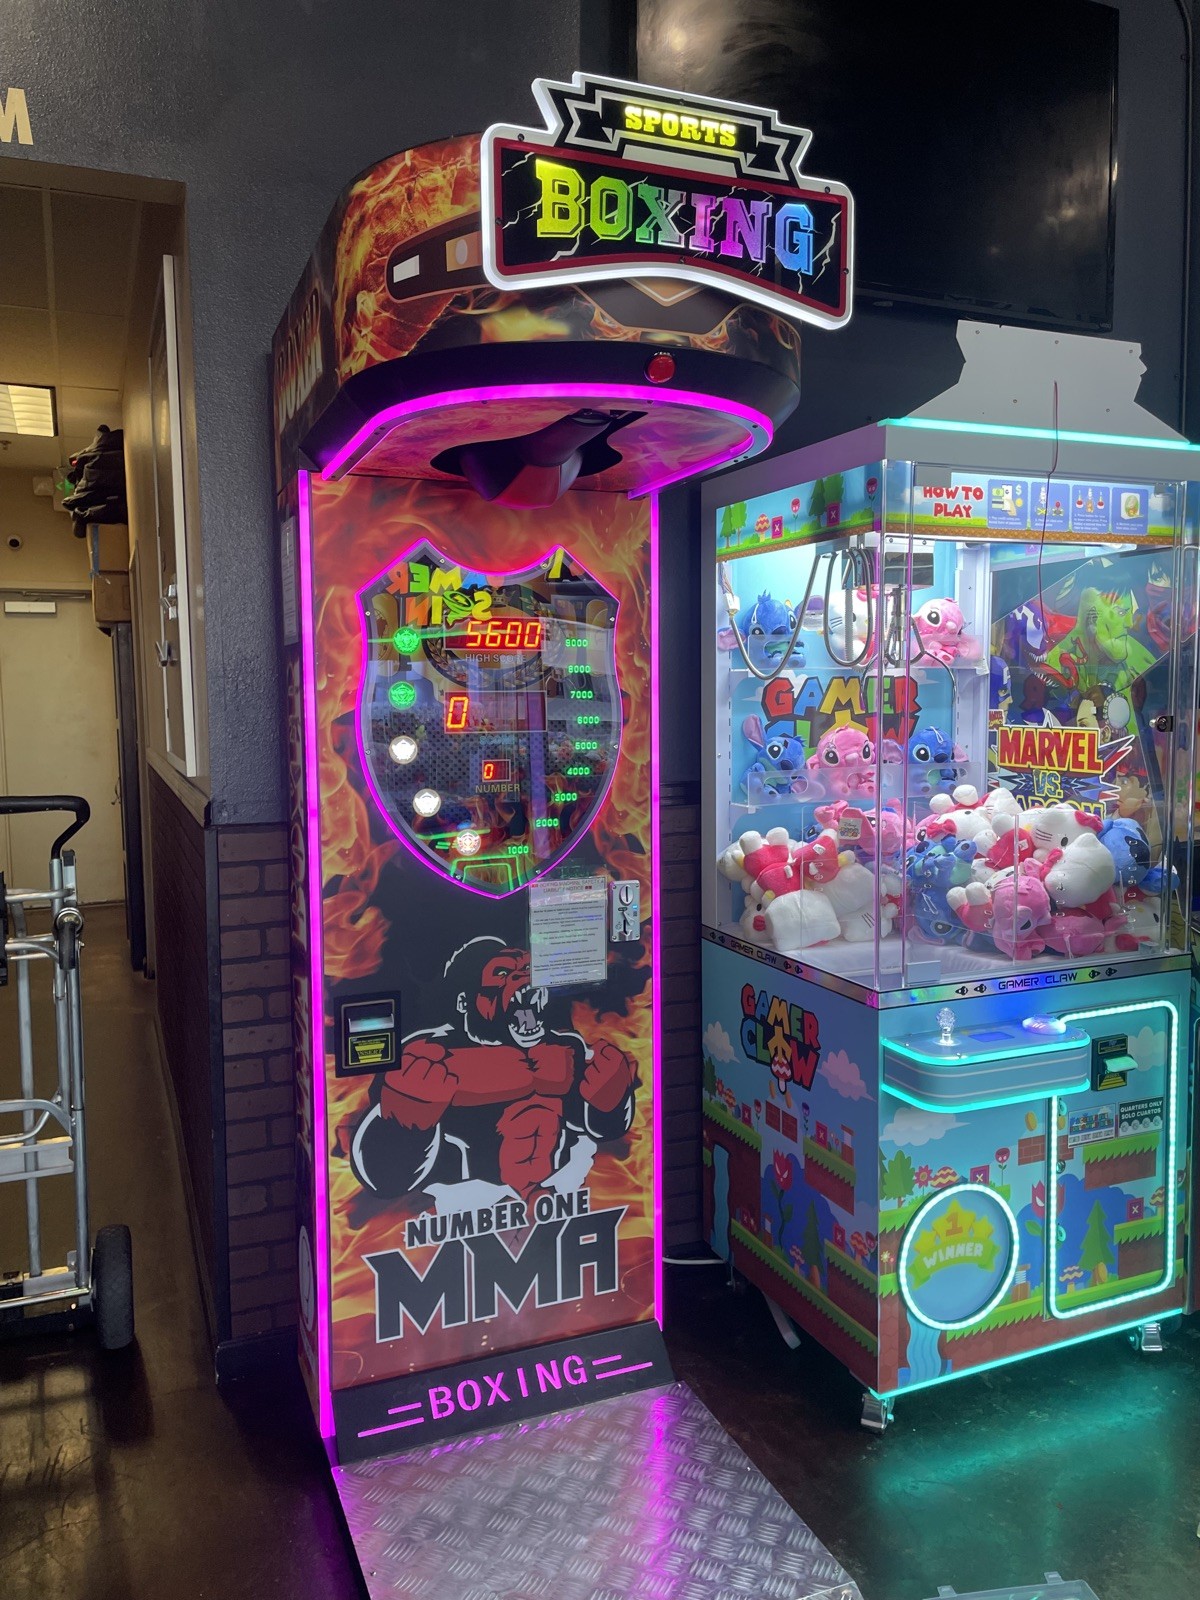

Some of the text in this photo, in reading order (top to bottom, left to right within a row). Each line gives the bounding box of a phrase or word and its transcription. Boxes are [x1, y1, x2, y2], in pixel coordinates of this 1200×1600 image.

[625, 105, 737, 147] SPORTS
[535, 158, 814, 276] BOXING
[923, 486, 984, 501] HOW TO
[934, 502, 973, 518] PLAY
[466, 620, 541, 647] 5600
[465, 653, 491, 663] HIGH
[568, 665, 591, 673] 8000
[570, 691, 593, 699] 7000
[761, 675, 922, 718] GAMER
[447, 696, 469, 728] 0
[577, 716, 600, 724] 6000
[575, 742, 598, 750] 5000
[998, 727, 1104, 775] MARVEL
[483, 763, 494, 779] 0
[567, 767, 590, 775] 4000
[475, 784, 520, 793] NUMBER
[1033, 769, 1063, 798] VS.
[554, 793, 577, 801] 3000
[535, 818, 559, 827] 2000
[508, 846, 529, 854] 1000
[730, 940, 777, 964] GAMER CLAW
[998, 972, 1078, 990] GAMER CLAW
[741, 983, 821, 1050] GAMER
[740, 1016, 820, 1092] CLAW
[1120, 1100, 1163, 1113] QUARTERS ONLY
[1121, 1108, 1161, 1120] SOLO CUARTOS
[406, 1188, 590, 1248] NUMBER ONE
[945, 1212, 963, 1236] 1
[923, 1242, 984, 1269] WINNER
[361, 1204, 630, 1343] MMA
[428, 1354, 588, 1420] BOXING
